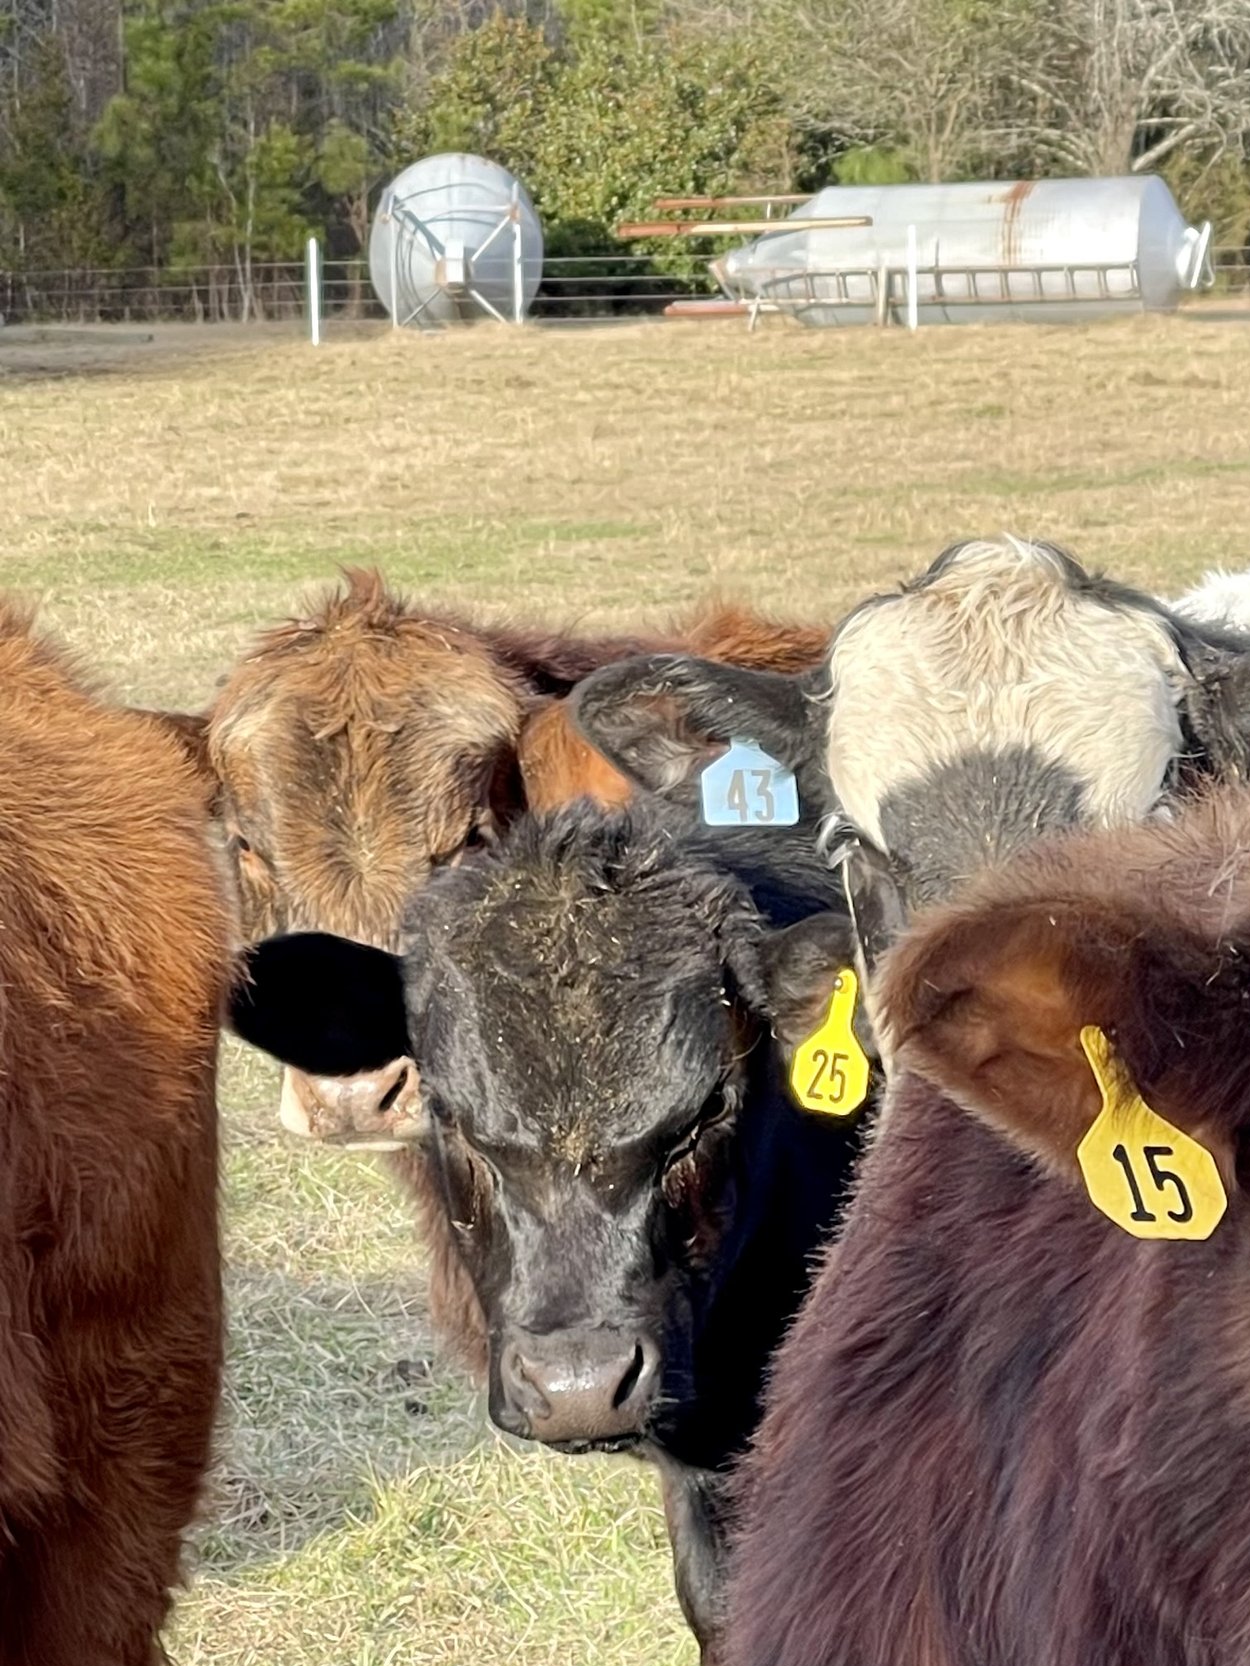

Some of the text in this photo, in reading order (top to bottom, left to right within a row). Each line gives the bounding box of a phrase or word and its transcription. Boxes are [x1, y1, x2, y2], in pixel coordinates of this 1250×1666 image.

[728, 769, 775, 823] 43
[806, 1049, 849, 1103] 25
[1112, 1144, 1193, 1223] 15
